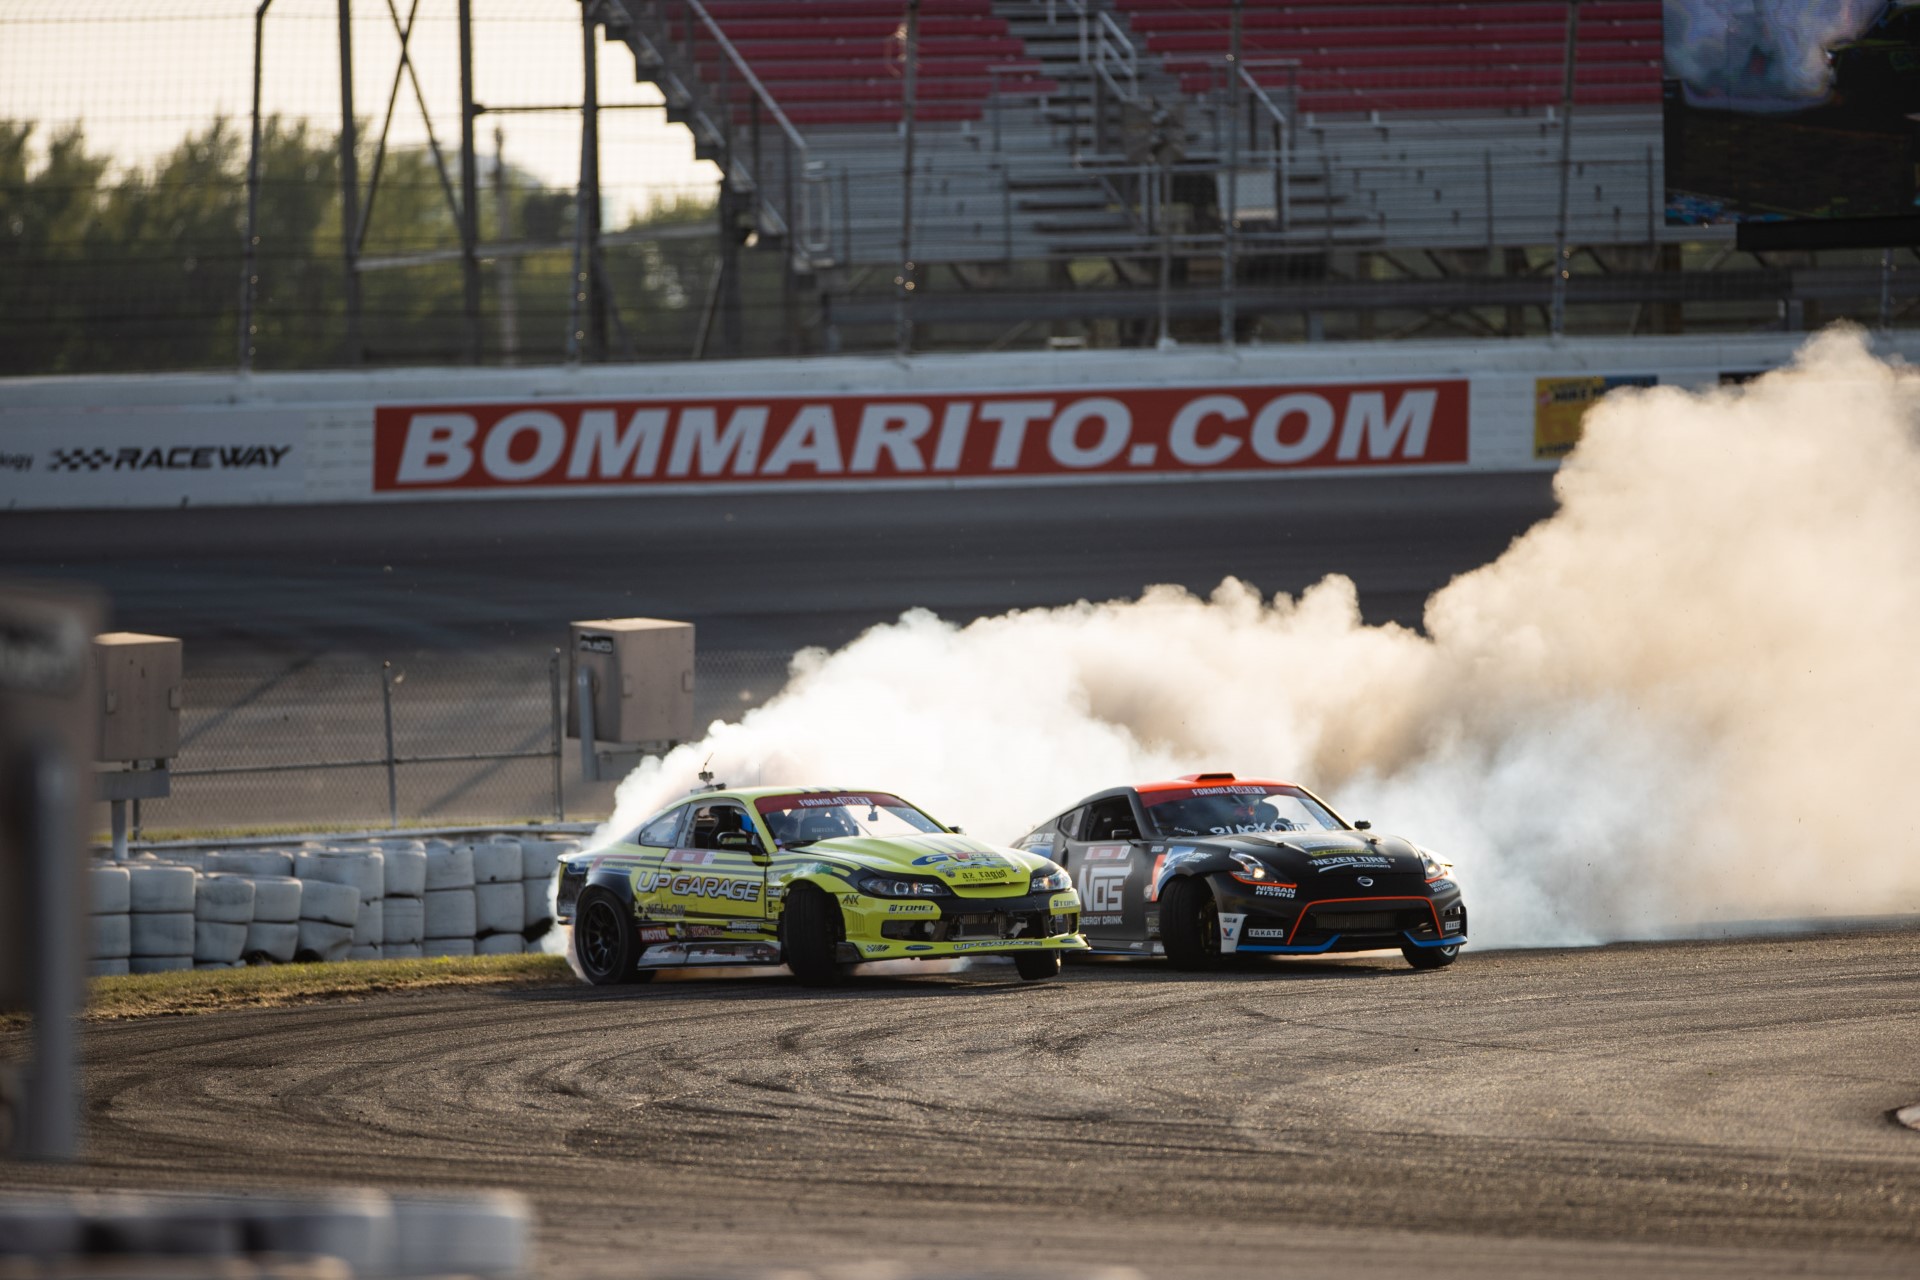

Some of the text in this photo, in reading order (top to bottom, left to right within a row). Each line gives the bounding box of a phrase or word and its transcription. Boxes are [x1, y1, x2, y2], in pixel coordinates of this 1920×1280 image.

[396, 388, 1439, 484] BOMMARITO.COM
[114, 444, 292, 471] RACEWAY
[1312, 856, 1389, 866] NEXEN TIRE
[636, 871, 763, 902] UP GARAGE
[1079, 860, 1133, 912] NOS
[1256, 885, 1296, 894] NISSAN
[1102, 915, 1123, 925] DRINK
[640, 928, 669, 940] MOTUL
